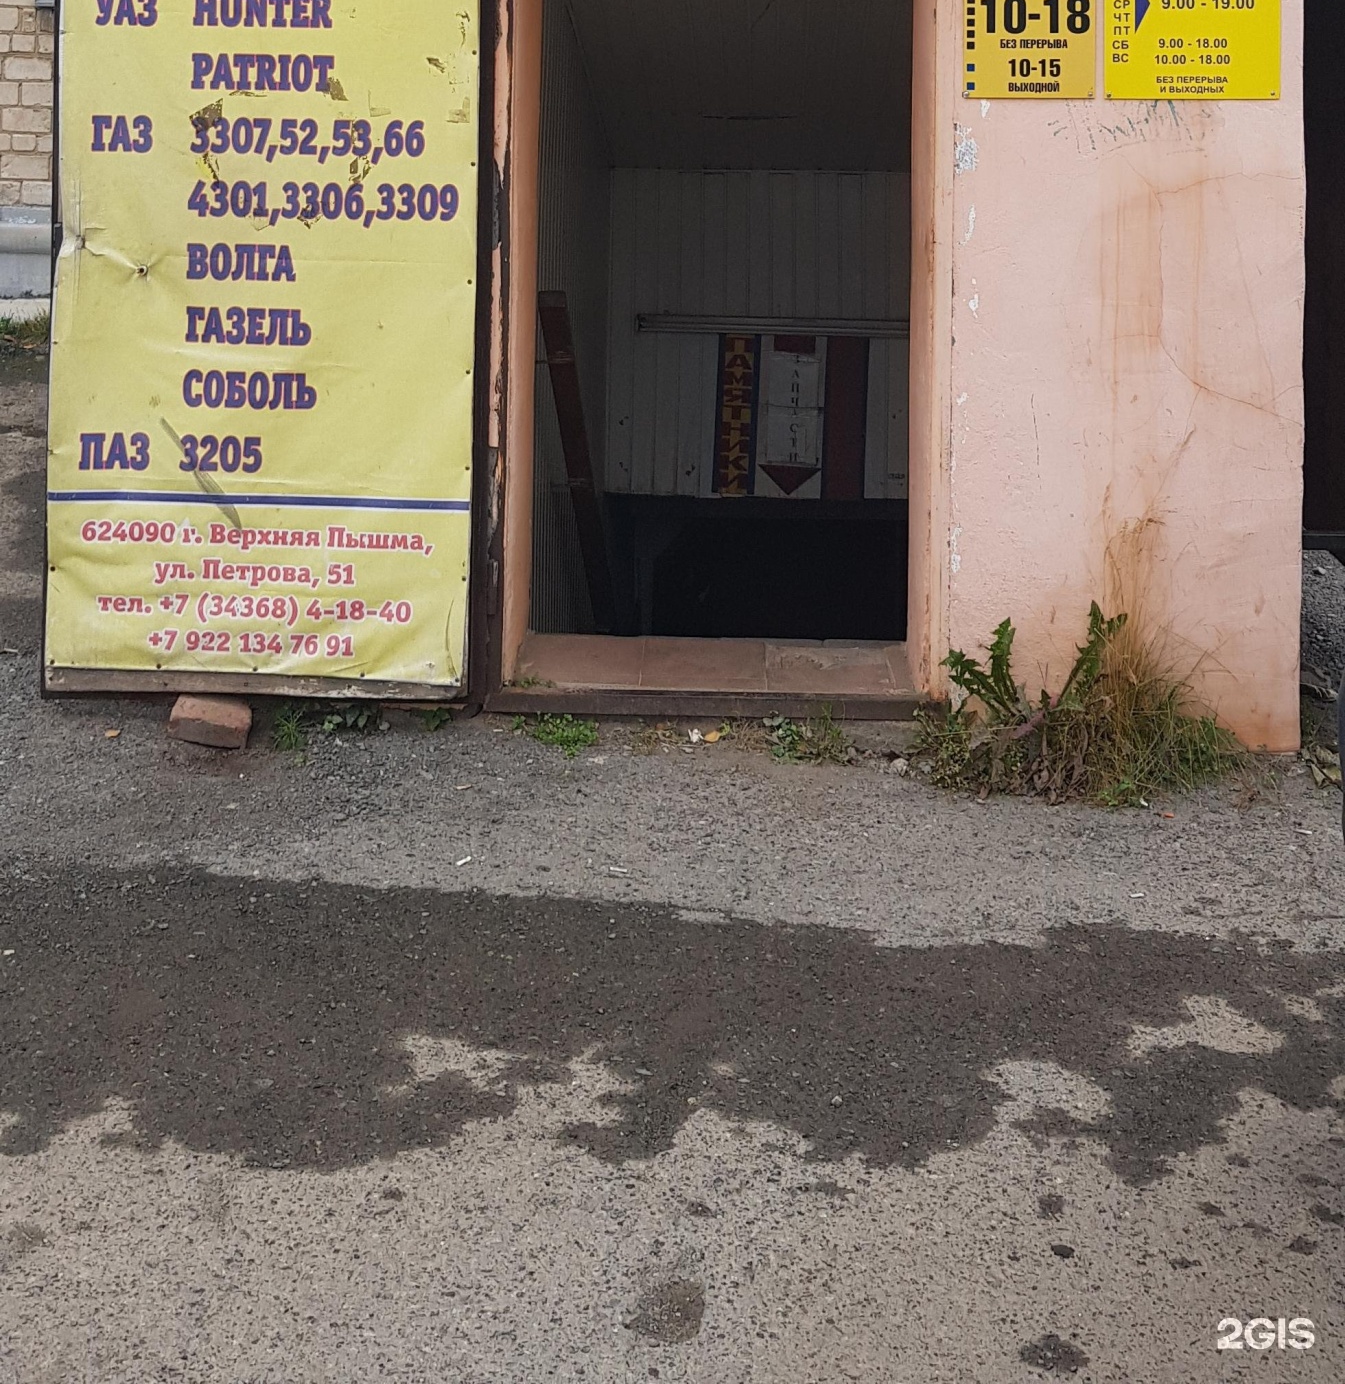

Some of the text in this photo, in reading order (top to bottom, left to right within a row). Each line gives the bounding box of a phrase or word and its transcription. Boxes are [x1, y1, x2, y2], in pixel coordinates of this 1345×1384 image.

[1113, 0, 1131, 10] СР
[1113, 12, 1131, 23] ЧТ
[1113, 25, 1131, 36] ПТ
[1000, 38, 1068, 49] БЕЗ ПЕРЕРЫВА
[1112, 40, 1130, 50] СБ
[1158, 38, 1185, 49] 9.00
[1196, 38, 1228, 49] 18.00
[1008, 58, 1061, 78] 10-15
[1112, 53, 1130, 63] ВС
[1154, 54, 1187, 65] 10.00
[1199, 54, 1231, 65] 18.00
[190, 53, 335, 92] PATRIOT
[1156, 76, 1228, 84] БЕЗ ПЕРЕРЫВА
[1008, 81, 1060, 93] ВЫХОДНОЙ
[1159, 86, 1225, 95] И ВЫХОДНЫХ
[91, 115, 425, 164] ГАЗ 3307,52,53,66
[187, 179, 460, 228] 4301,3306,3309
[186, 243, 297, 282] ВОЛГА
[185, 306, 312, 346] ГАЗЕЛЬ
[182, 369, 318, 410] СОБОЛЬ
[79, 433, 263, 473] ПАЗ 3205
[81, 521, 434, 556] 624090 г. Верхняя Пышма,
[154, 559, 355, 588] ул. Петрова, 51
[98, 592, 412, 627] тел. +7 (34368) 4-18-40
[149, 630, 354, 657] +7 922 134 76 91
